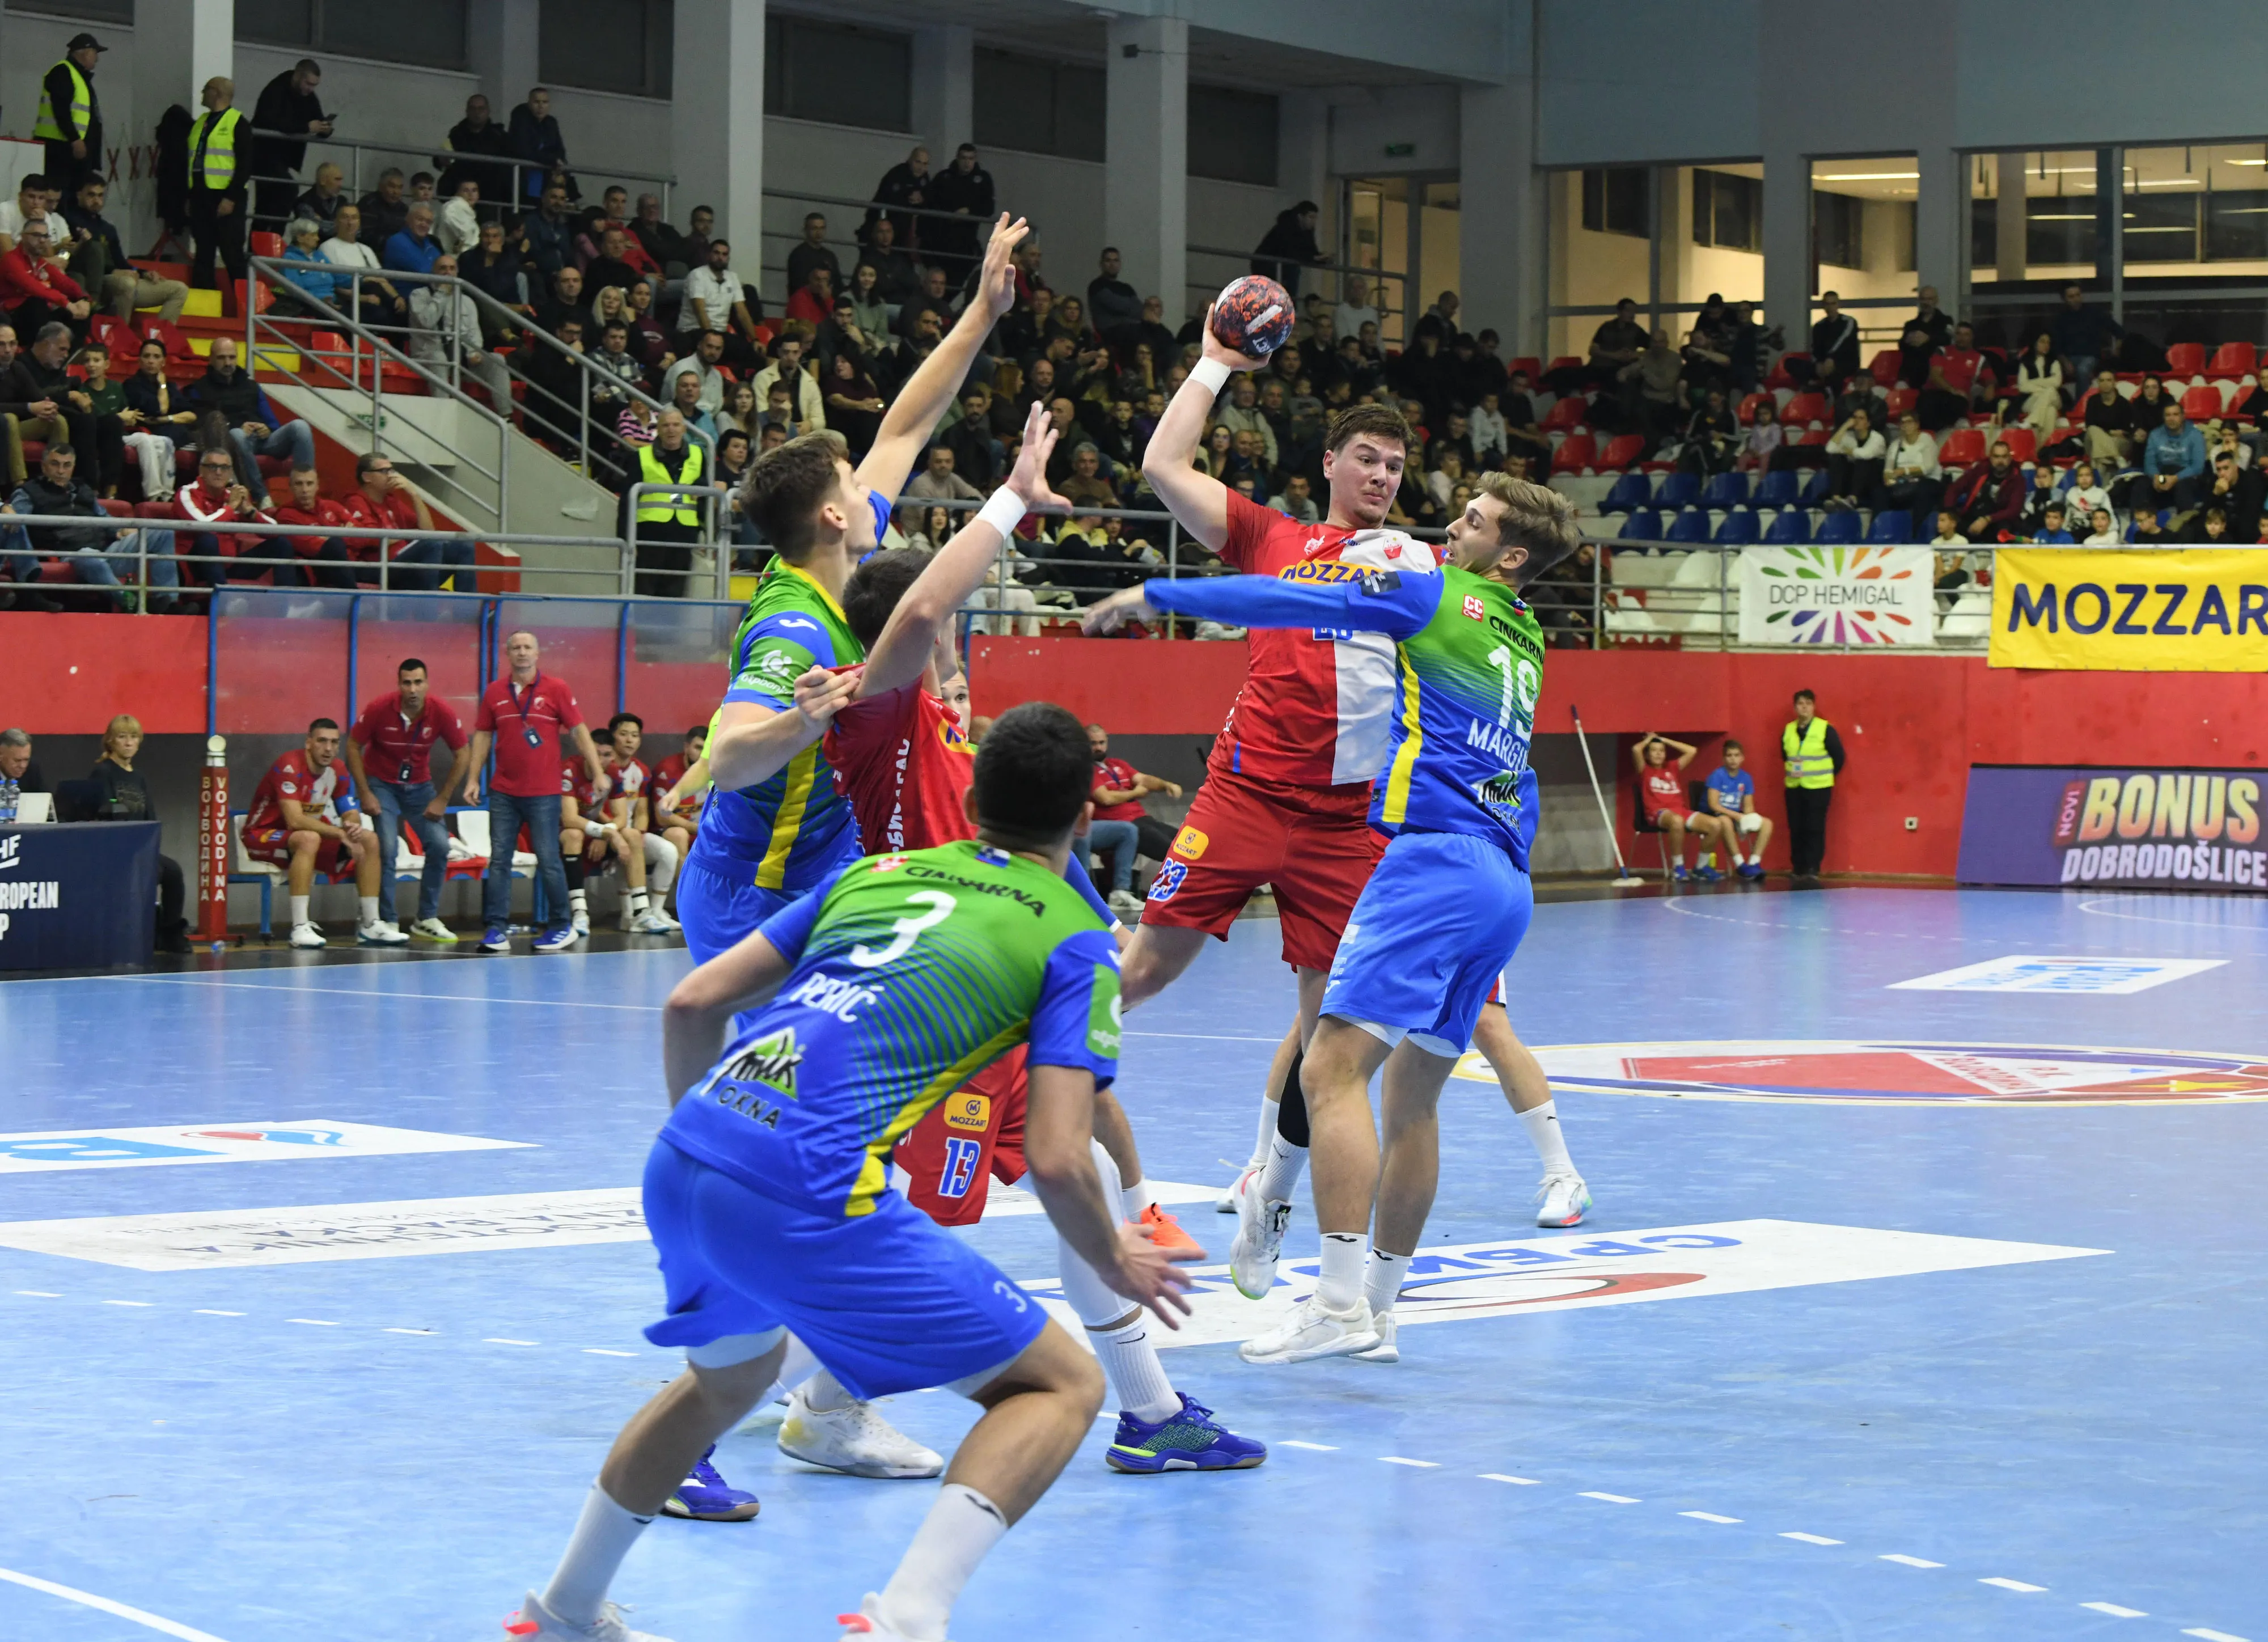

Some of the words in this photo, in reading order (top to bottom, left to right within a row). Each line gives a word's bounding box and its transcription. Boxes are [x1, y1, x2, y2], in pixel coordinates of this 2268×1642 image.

[1464, 595, 1484, 615] CC
[1770, 585, 1809, 605] DCP
[1814, 585, 1902, 606] HEMIGAL
[2008, 582, 2268, 635] MOZZAR
[1489, 616, 1545, 665] CINKARN
[1487, 644, 1538, 742] 19
[1466, 718, 1528, 772] MARGU
[2058, 790, 2080, 837] NOVI
[2077, 774, 2259, 844] BONUS
[0, 834, 22, 859] HF
[214, 776, 227, 902] VOJVODINA
[2060, 840, 2267, 887] DOBRODOŠLICE
[0, 881, 59, 909] ROPEAN
[848, 890, 958, 967] 3
[789, 971, 885, 1023] PERIĆ
[718, 1084, 782, 1130] OKNA
[949, 1115, 987, 1127] MOZZART
[937, 1136, 981, 1198] 13
[164, 1219, 649, 1252] RGOTEHNIKA
[993, 1280, 1027, 1313] 3
